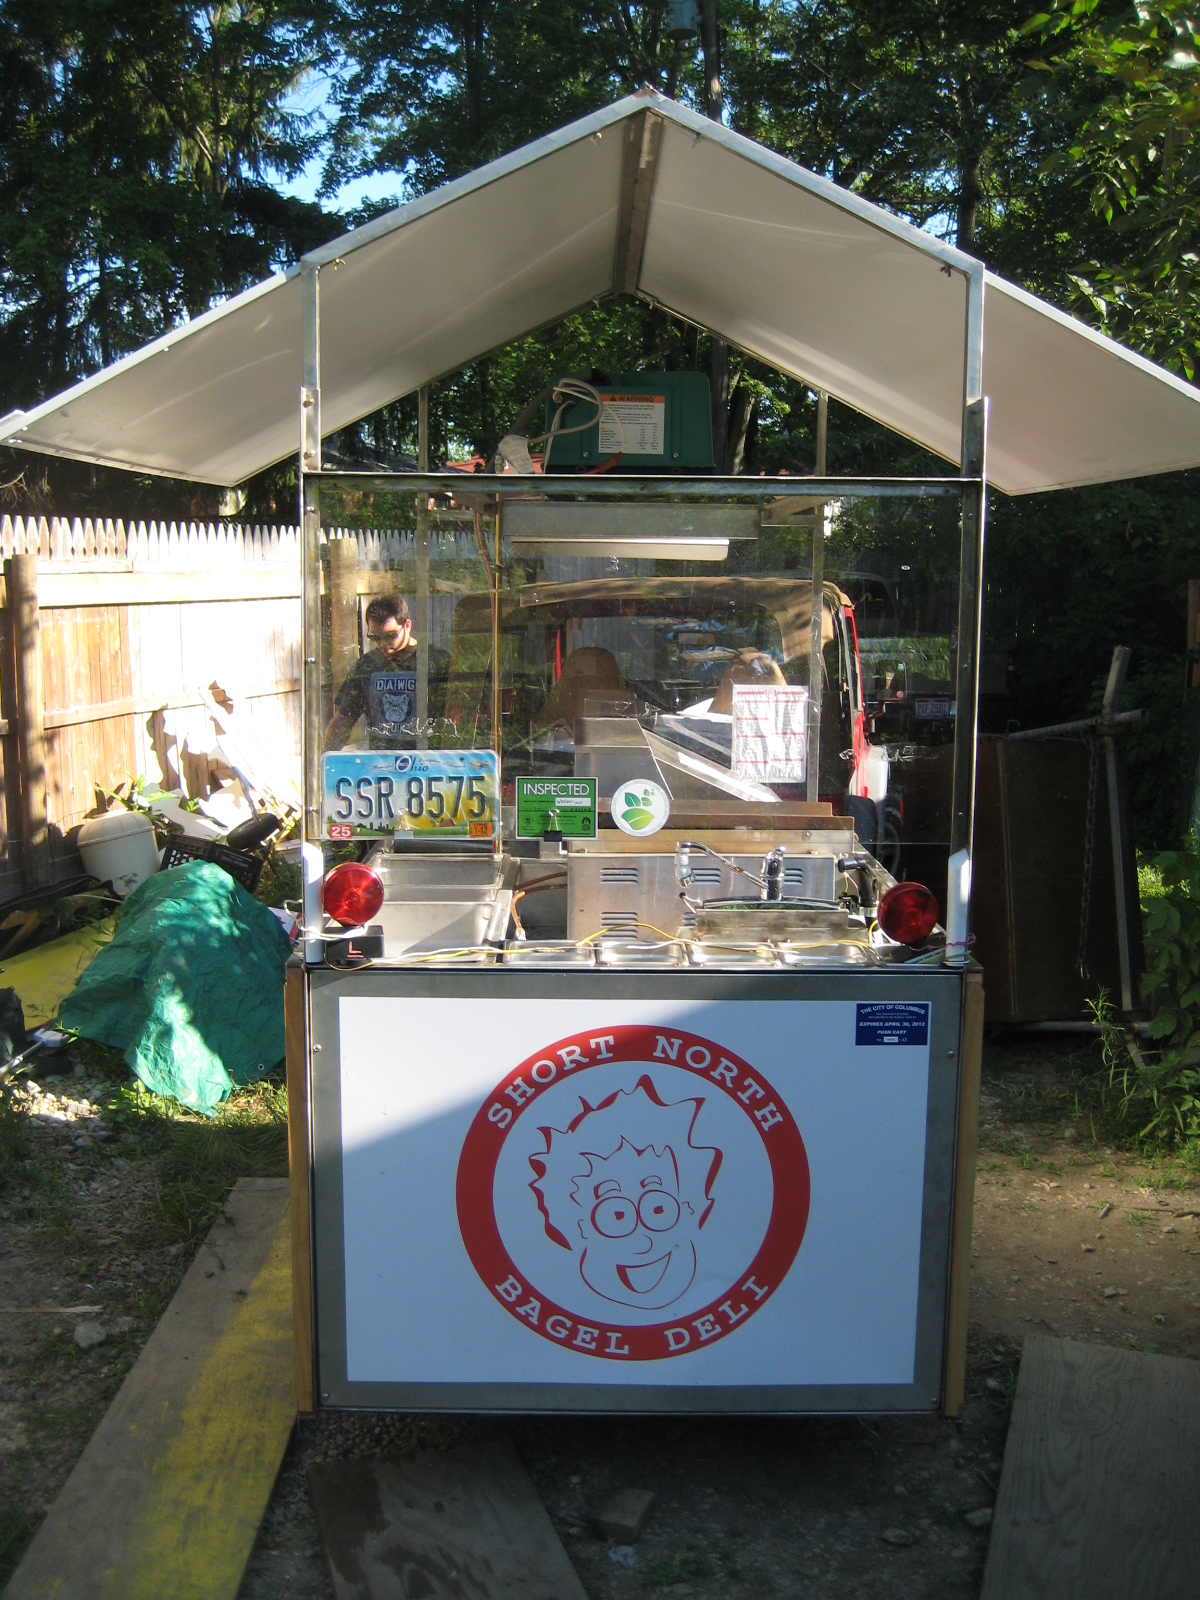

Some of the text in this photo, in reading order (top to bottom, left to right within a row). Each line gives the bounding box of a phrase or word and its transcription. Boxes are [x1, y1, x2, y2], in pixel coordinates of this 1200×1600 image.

[336, 776, 486, 819] SSR 8575
[523, 783, 590, 796] INSPECTED
[331, 826, 351, 837] 25
[861, 1006, 872, 1014] THE
[895, 1004, 926, 1015] COLUMBUS
[487, 1035, 784, 1132] SHORT NORTH
[495, 1274, 769, 1355] BAGEL DELI
